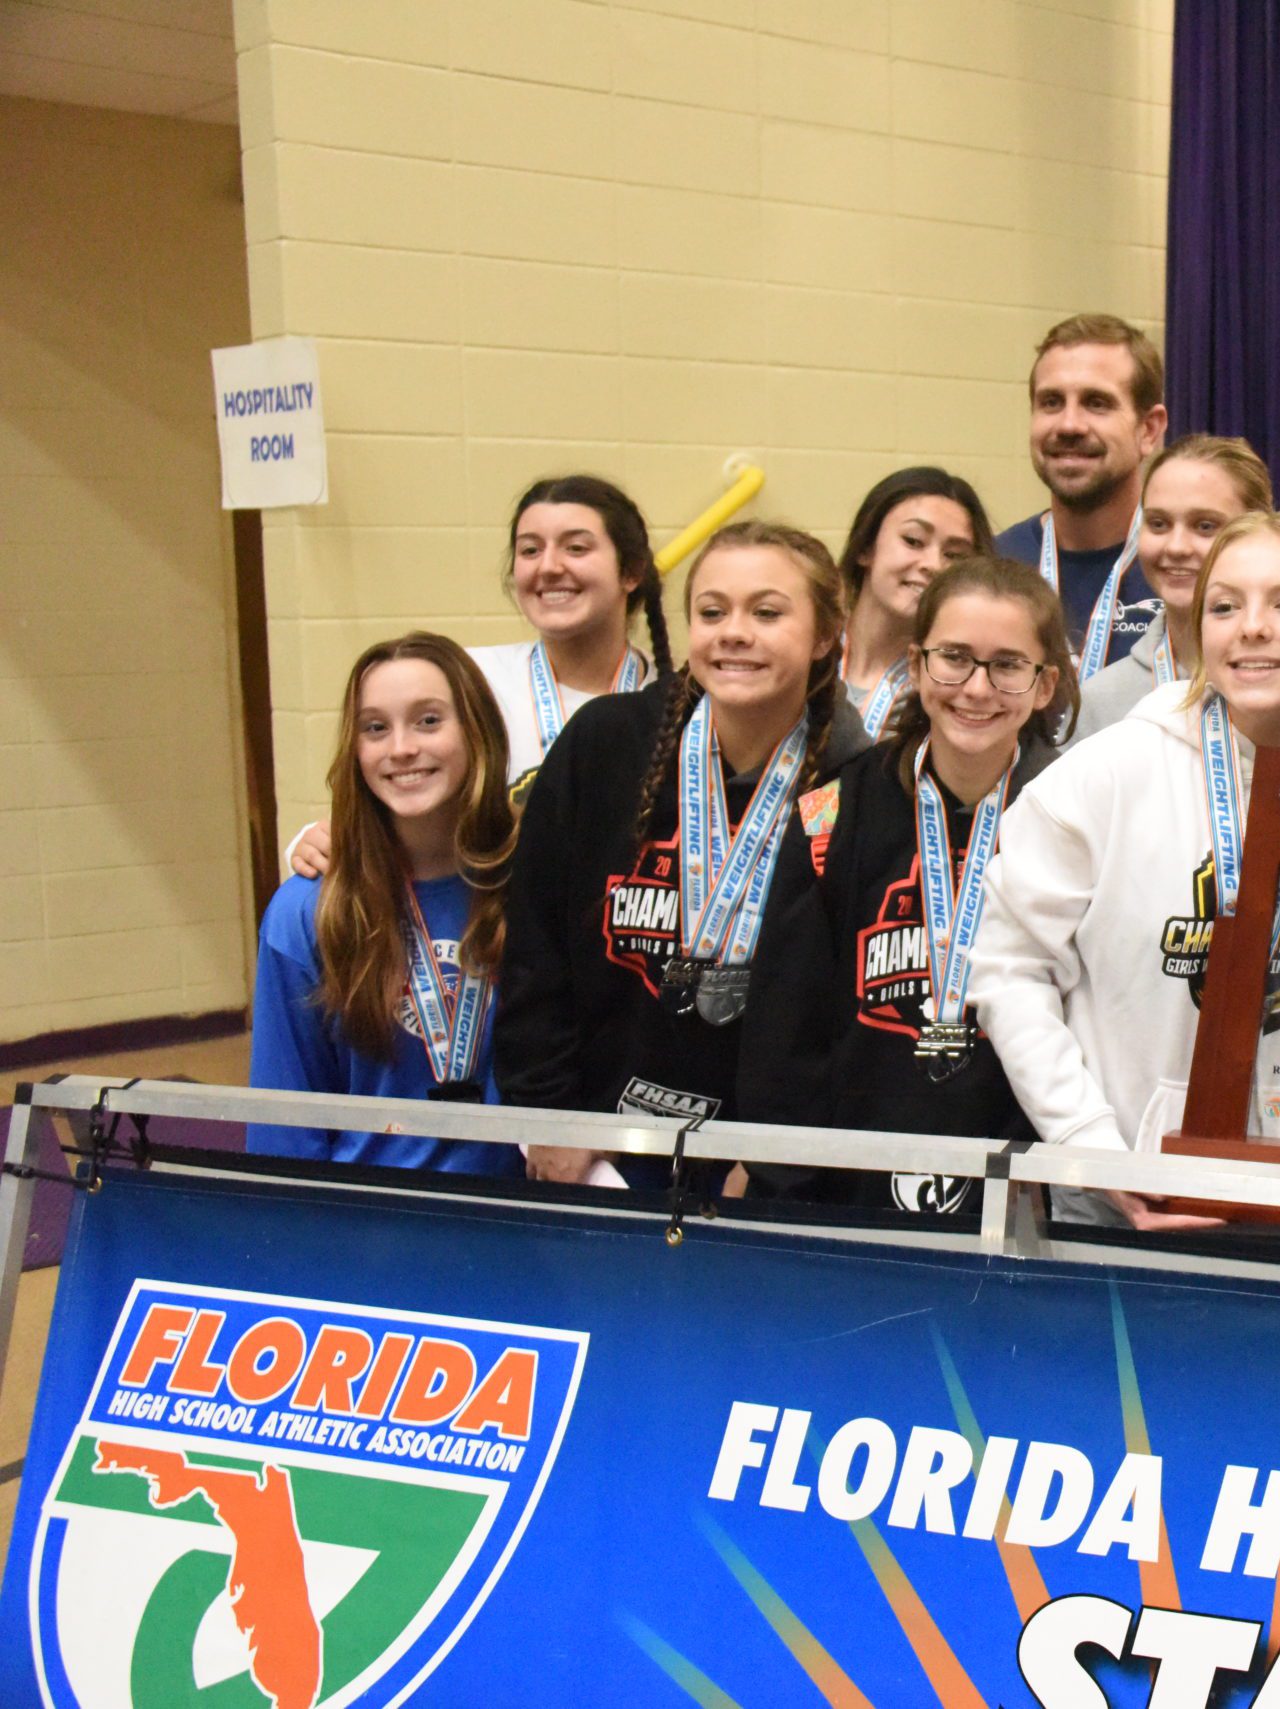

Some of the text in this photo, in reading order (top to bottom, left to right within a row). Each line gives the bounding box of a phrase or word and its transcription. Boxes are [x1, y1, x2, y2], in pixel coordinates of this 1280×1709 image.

[224, 382, 313, 417] HOSPITALITY
[251, 433, 295, 462] ROOM
[687, 719, 703, 856] WEIGHTLIFTING
[721, 771, 786, 901] WEIGHTLIFTING
[1210, 739, 1238, 890] WEIGHTLIFTING
[919, 788, 946, 930] WEIGHTLIFTING
[957, 804, 996, 947] WEIGHTLIFTING
[631, 1082, 709, 1115] FHSAA
[107, 1390, 526, 1473] HIGH SCHOOL ATHLETIC ASSOCIATION
[118, 1302, 540, 1441] FLORIDA
[707, 1400, 1163, 1563] FLORIDA
